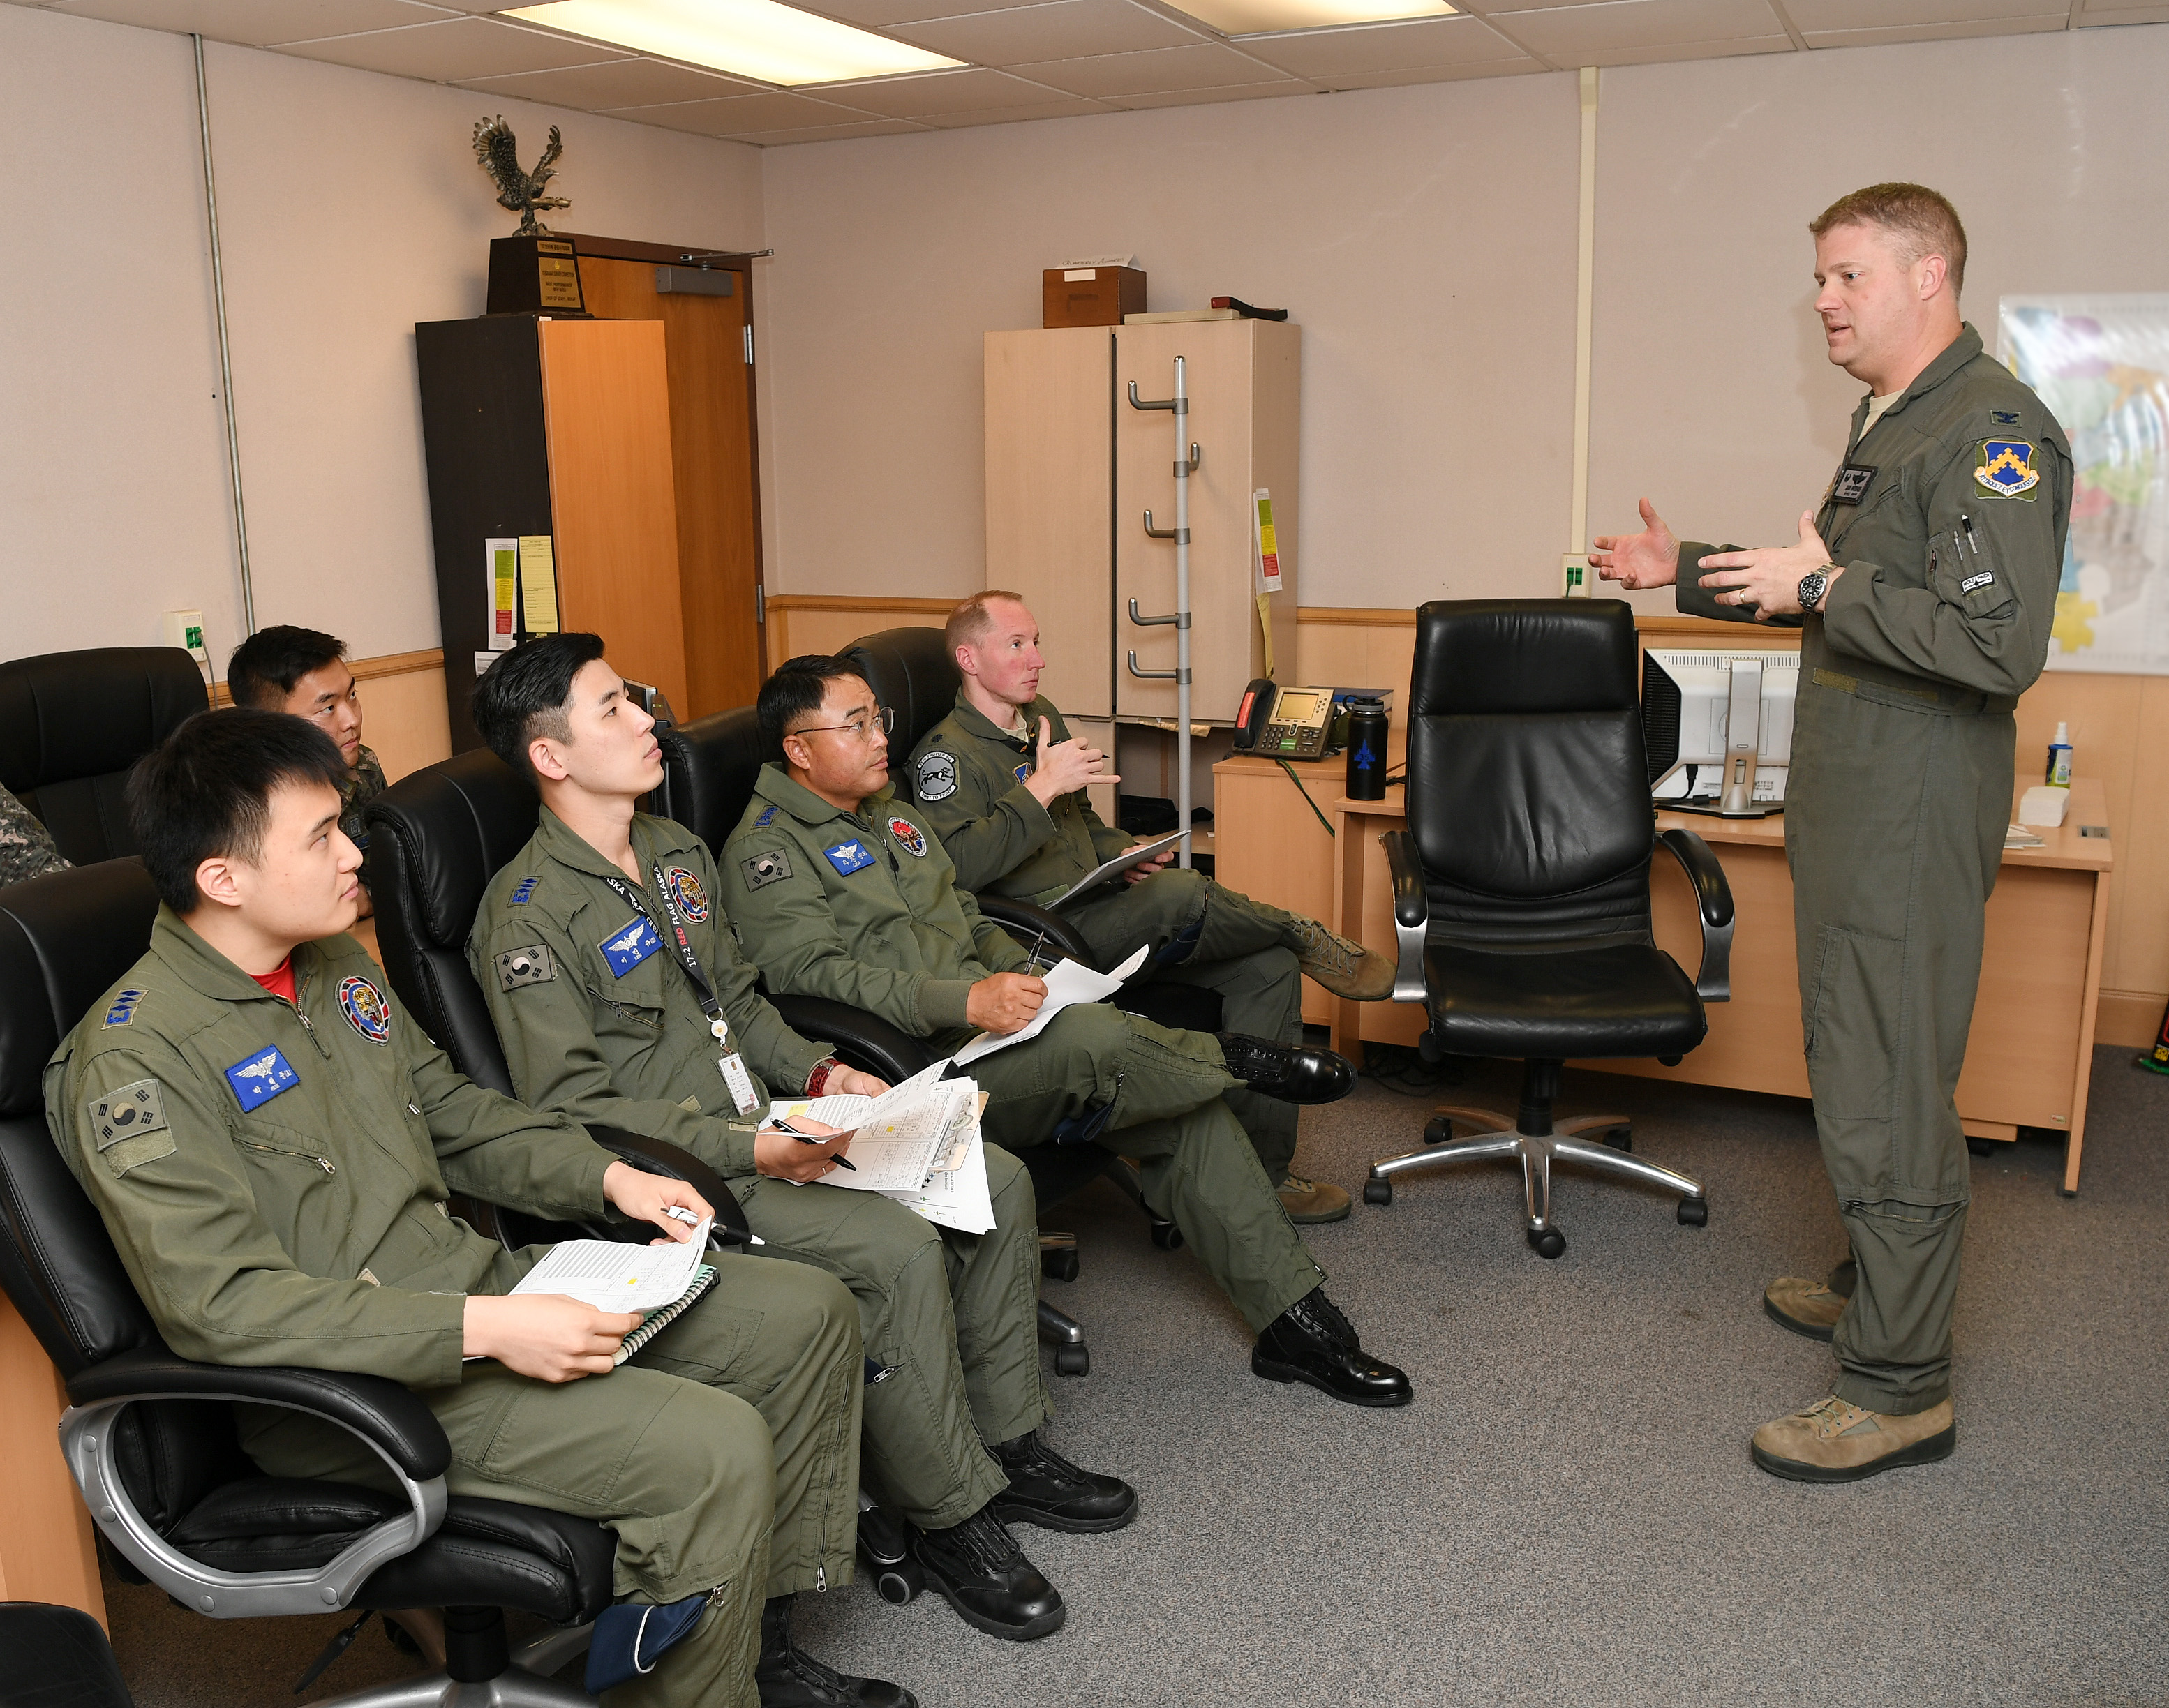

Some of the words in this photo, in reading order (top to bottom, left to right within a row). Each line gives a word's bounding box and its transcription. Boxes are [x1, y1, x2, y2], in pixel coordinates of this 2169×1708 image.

[1979, 474, 2003, 490] ATTAQUEZ
[606, 877, 625, 894] SKA
[653, 866, 671, 900] ALASKA
[666, 903, 680, 925] FLAG
[676, 927, 688, 945] RED
[683, 947, 697, 968] 17-2
